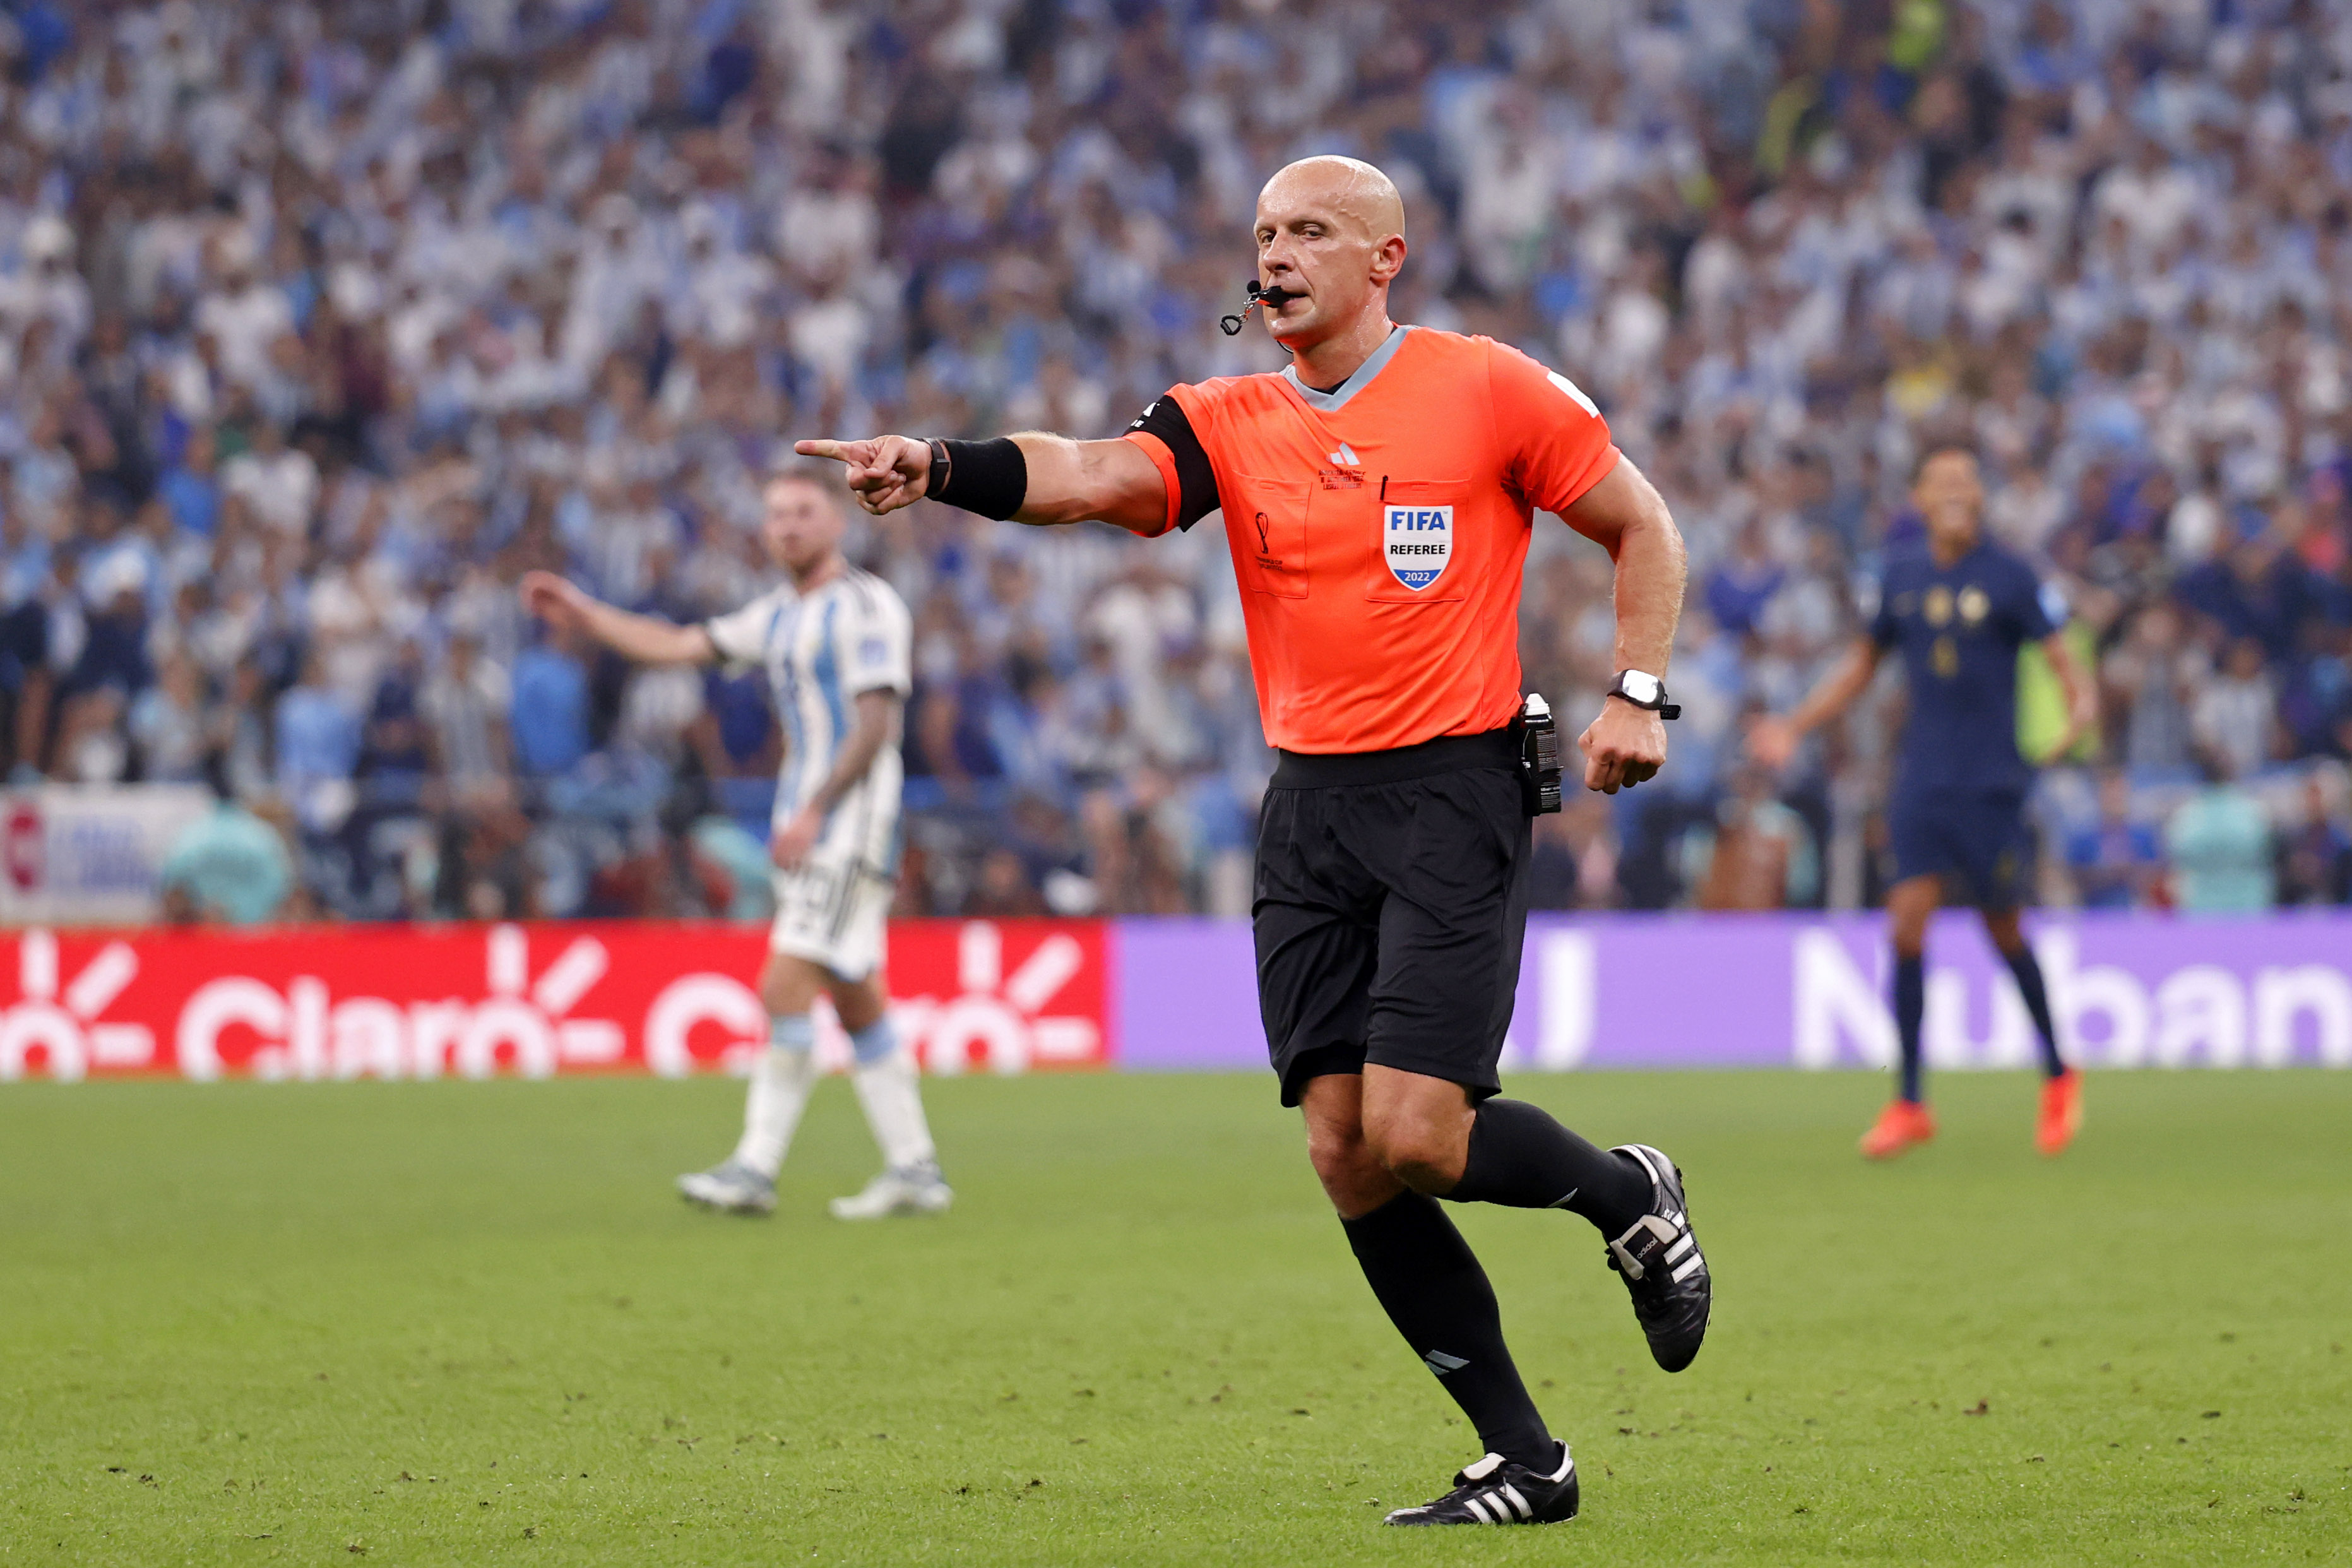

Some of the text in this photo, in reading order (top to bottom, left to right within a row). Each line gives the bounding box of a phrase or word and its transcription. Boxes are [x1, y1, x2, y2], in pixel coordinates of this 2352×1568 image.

[1391, 511, 1446, 530] FIFA
[1391, 545, 1446, 554] REFEREE
[1405, 572, 1430, 581] 2022
[175, 972, 559, 1081] Claro
[1637, 1237, 1658, 1259] adidas
